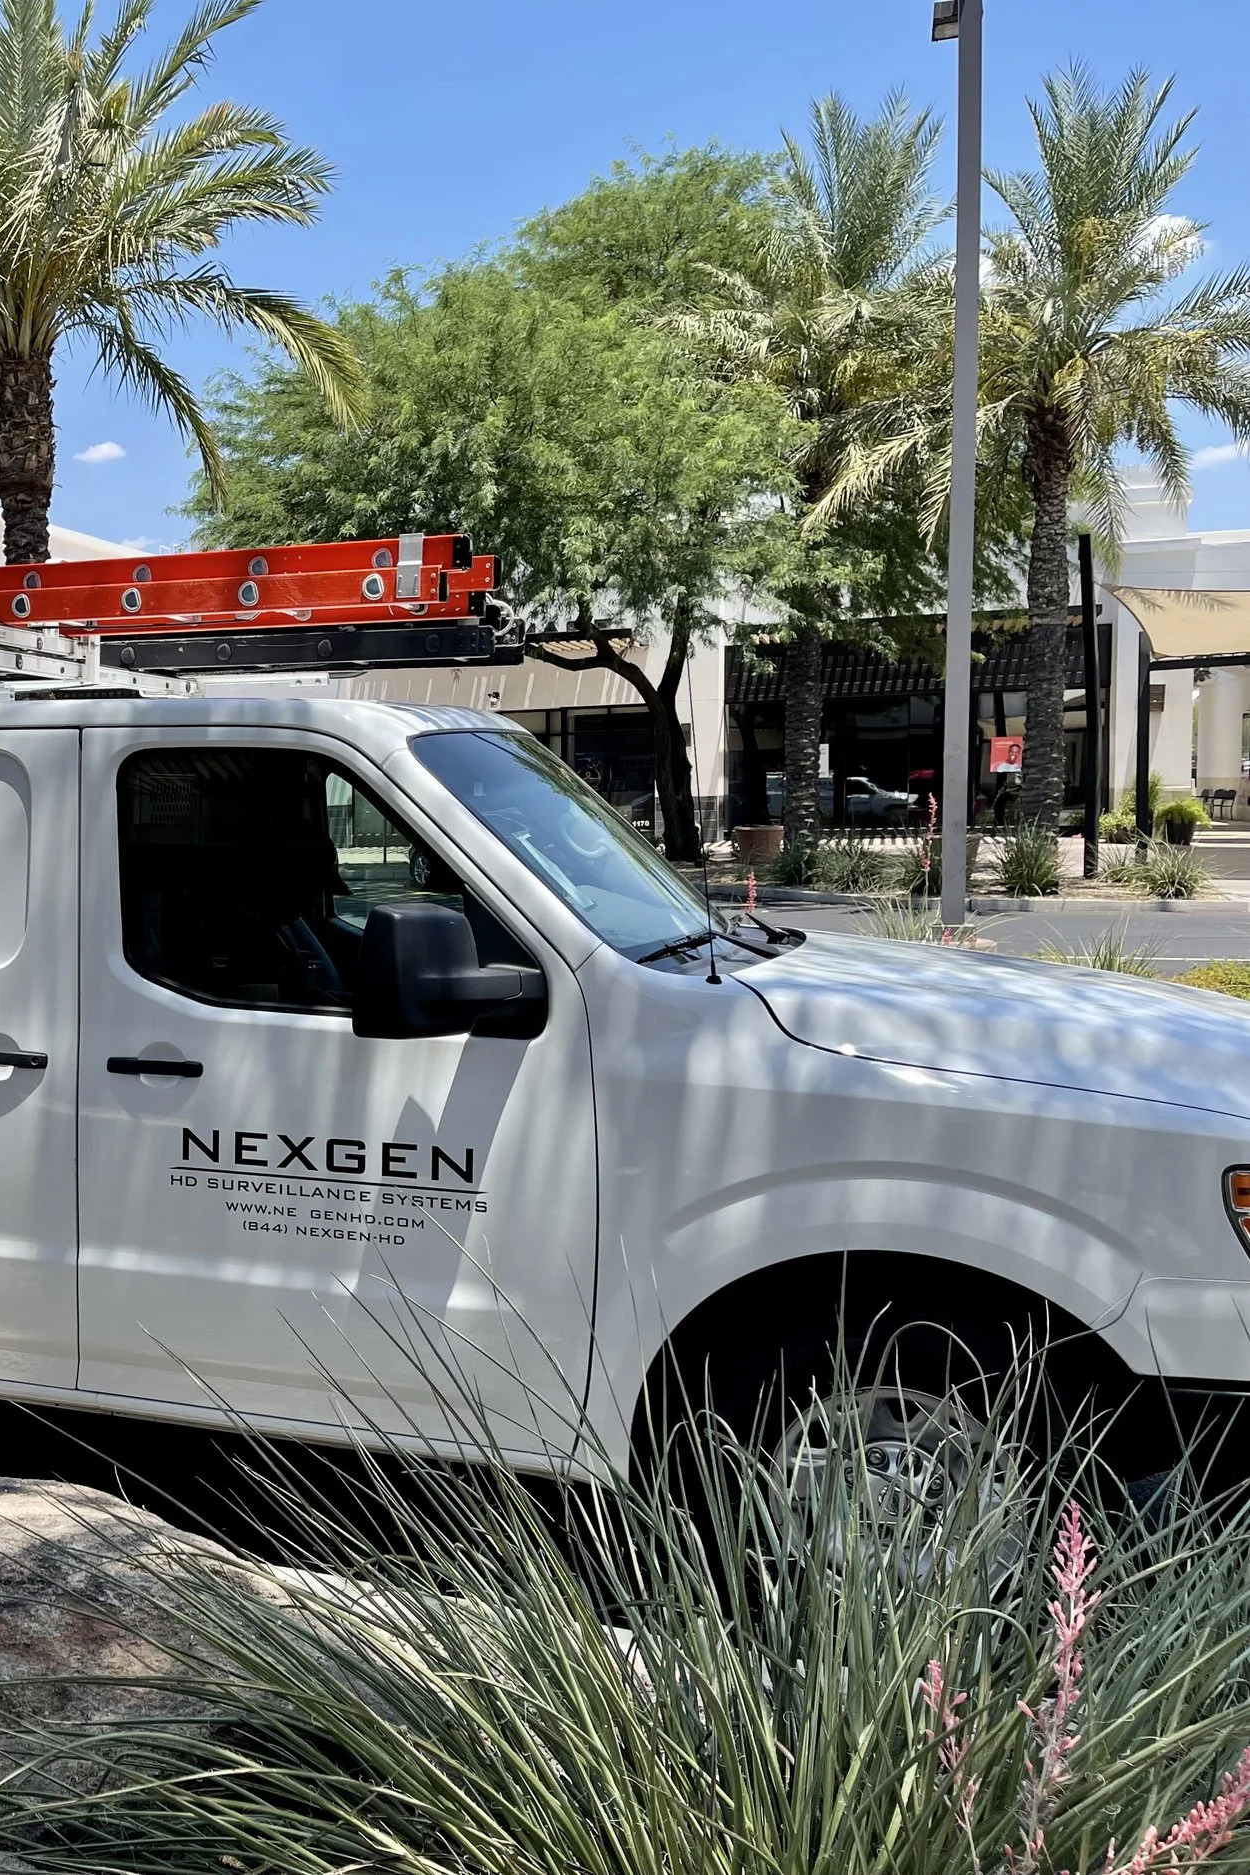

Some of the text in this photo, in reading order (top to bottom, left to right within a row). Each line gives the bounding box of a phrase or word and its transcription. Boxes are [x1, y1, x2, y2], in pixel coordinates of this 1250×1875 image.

[181, 1127, 474, 1184] NEXGEN
[170, 1174, 488, 1213] HD SURVEILLANCE SYSTEMS
[242, 1220, 405, 1245] (844) NEXGEN-HD
